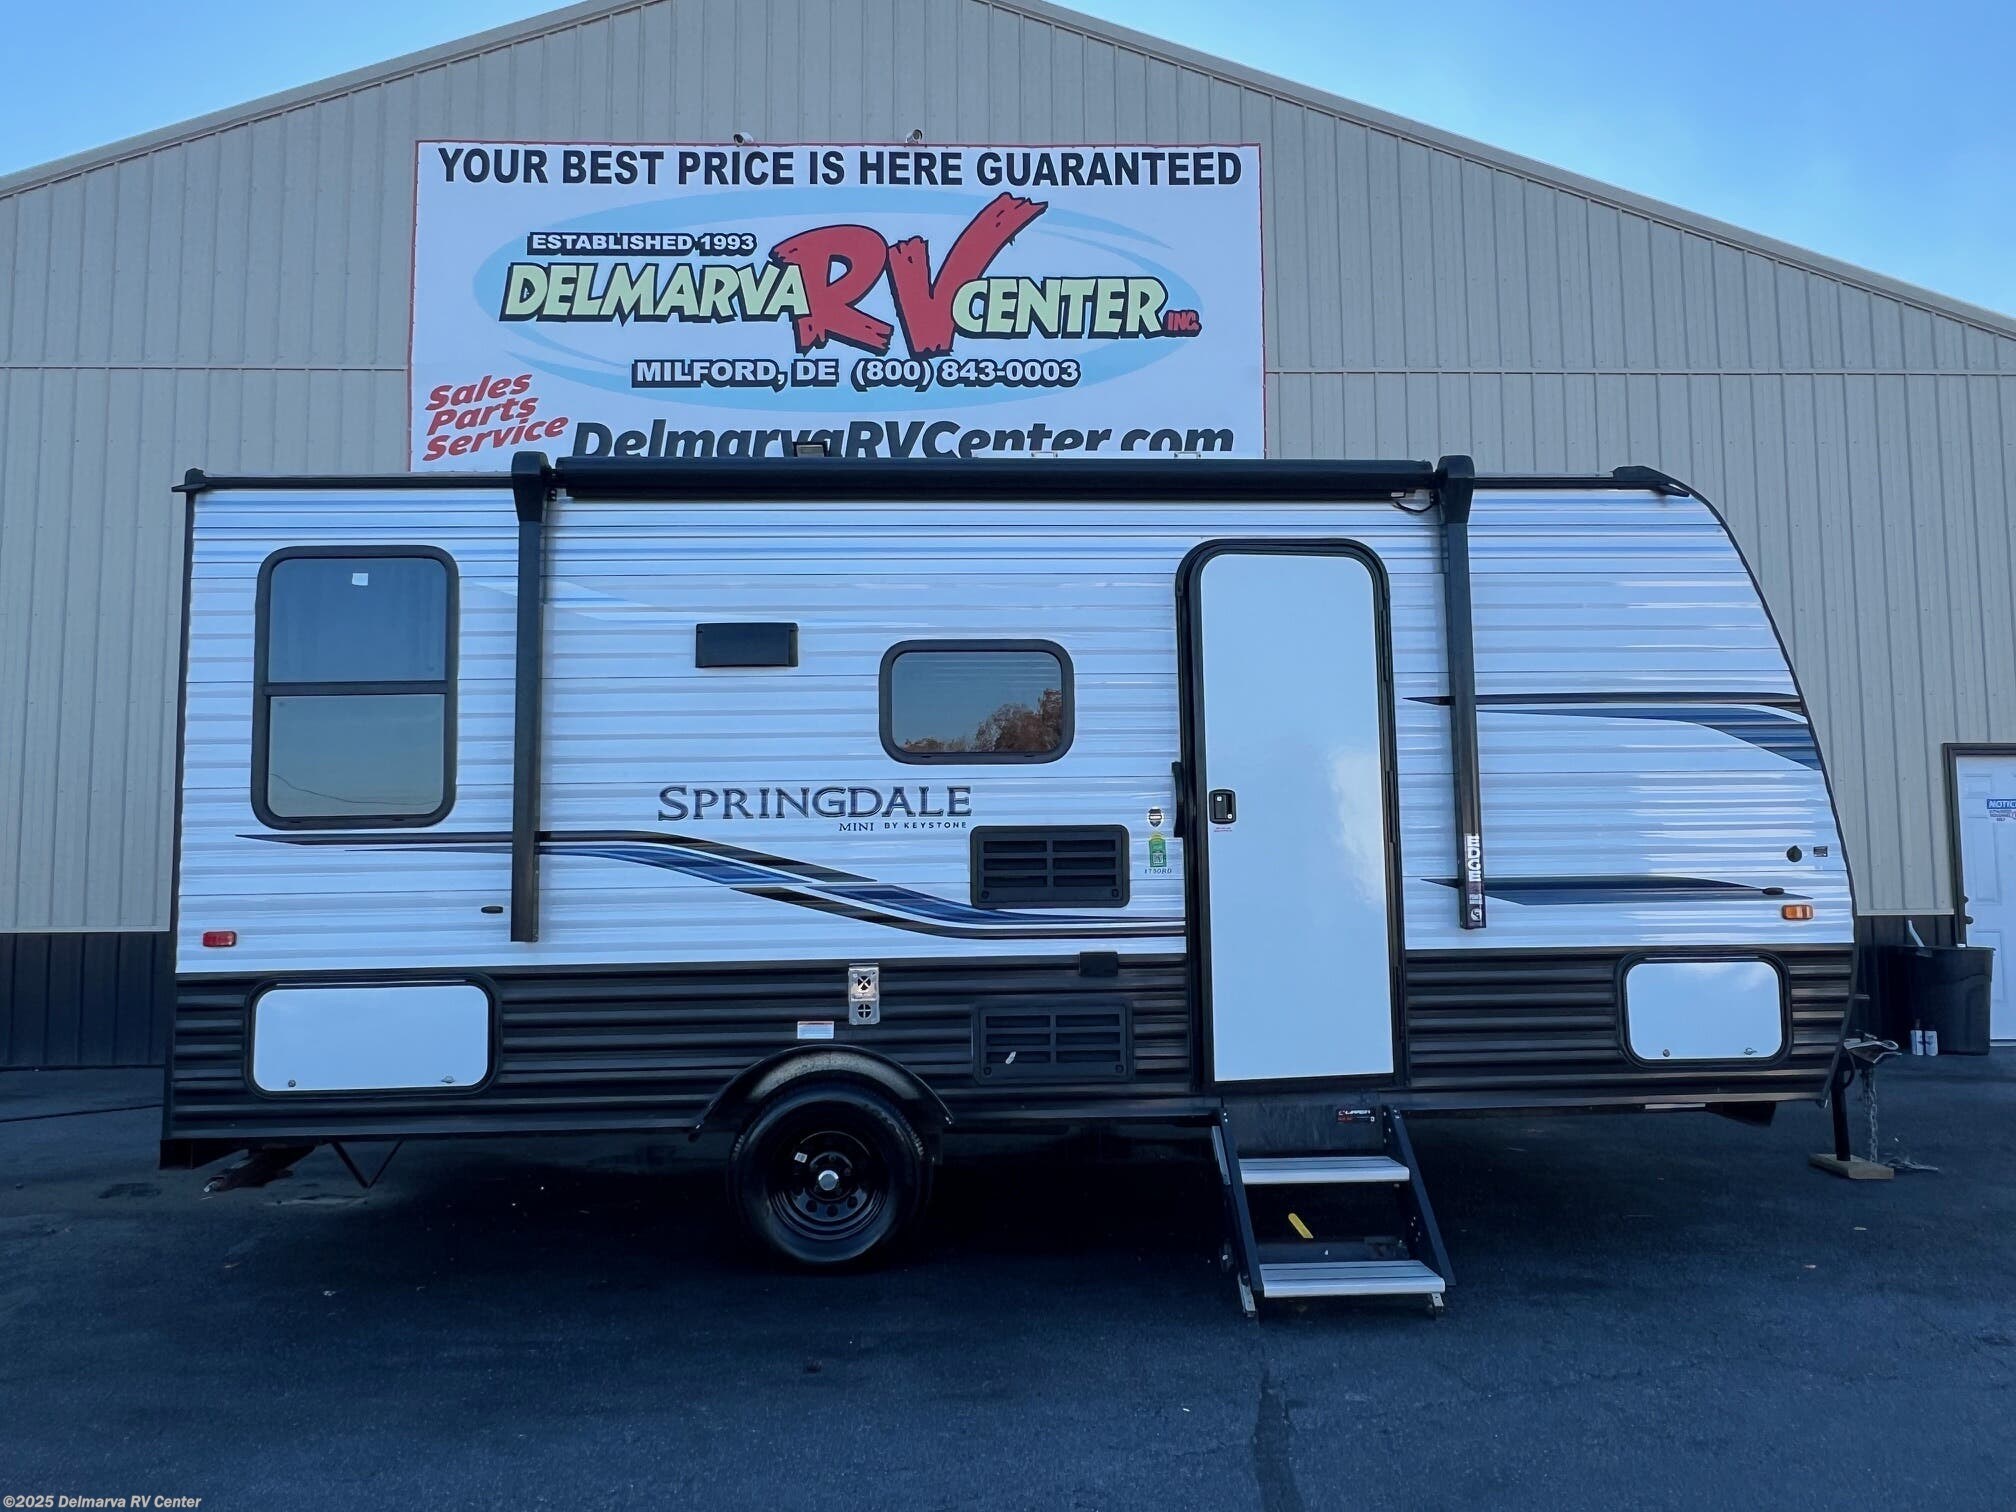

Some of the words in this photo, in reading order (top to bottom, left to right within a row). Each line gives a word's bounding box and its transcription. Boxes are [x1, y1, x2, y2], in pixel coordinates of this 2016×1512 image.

[437, 148, 548, 184] YOUR
[562, 149, 665, 185] BEST
[677, 150, 794, 186] PRICE
[809, 151, 846, 186] IS
[859, 151, 963, 186] HERE
[976, 151, 1242, 187] GUARANTEED
[530, 233, 694, 253] ESTABLISHED
[699, 233, 756, 252] 1993
[501, 262, 812, 323] DELMARVA
[769, 192, 1049, 357] RV
[952, 277, 1168, 338] CENTER
[635, 360, 787, 387] MILFORD,
[794, 360, 838, 383] DE
[855, 360, 933, 387] (800)
[940, 360, 1080, 384] 843-0003
[425, 374, 532, 410] Sales
[426, 397, 539, 436] Parts
[422, 417, 569, 461] Service
[657, 785, 973, 822] SPRINGDALE
[1988, 799, 2016, 809] NOTIC
[838, 822, 874, 832] MINI
[884, 821, 898, 830] BY
[904, 821, 968, 829] KEYSTONE
